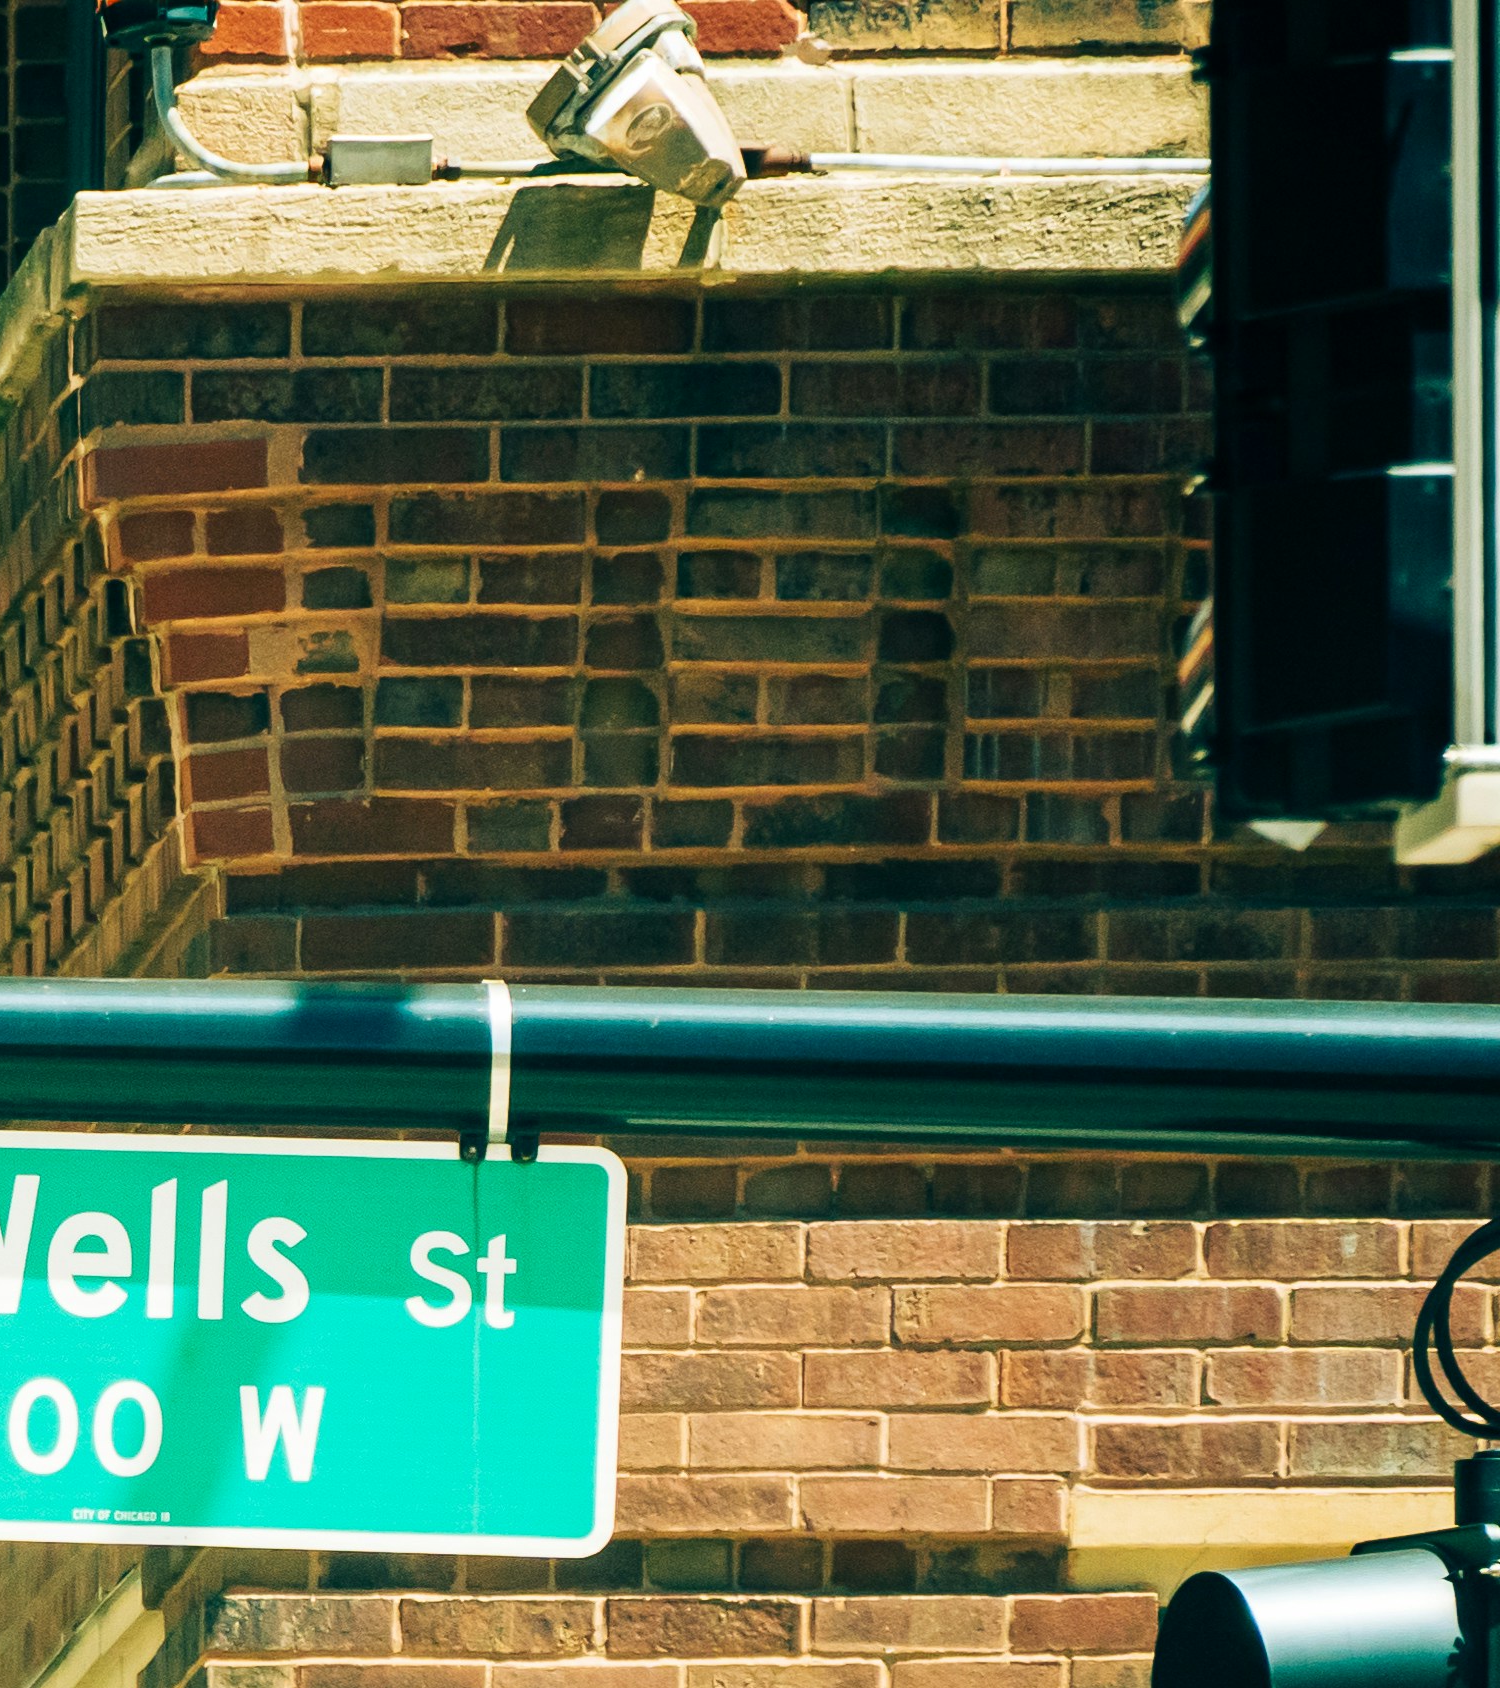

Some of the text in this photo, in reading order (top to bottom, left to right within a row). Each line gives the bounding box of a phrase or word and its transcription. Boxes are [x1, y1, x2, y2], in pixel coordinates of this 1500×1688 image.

[405, 1230, 518, 1330] St
[239, 1384, 327, 1484] W
[72, 1507, 95, 1520] CITY
[113, 1510, 157, 1521] CHICAGO
